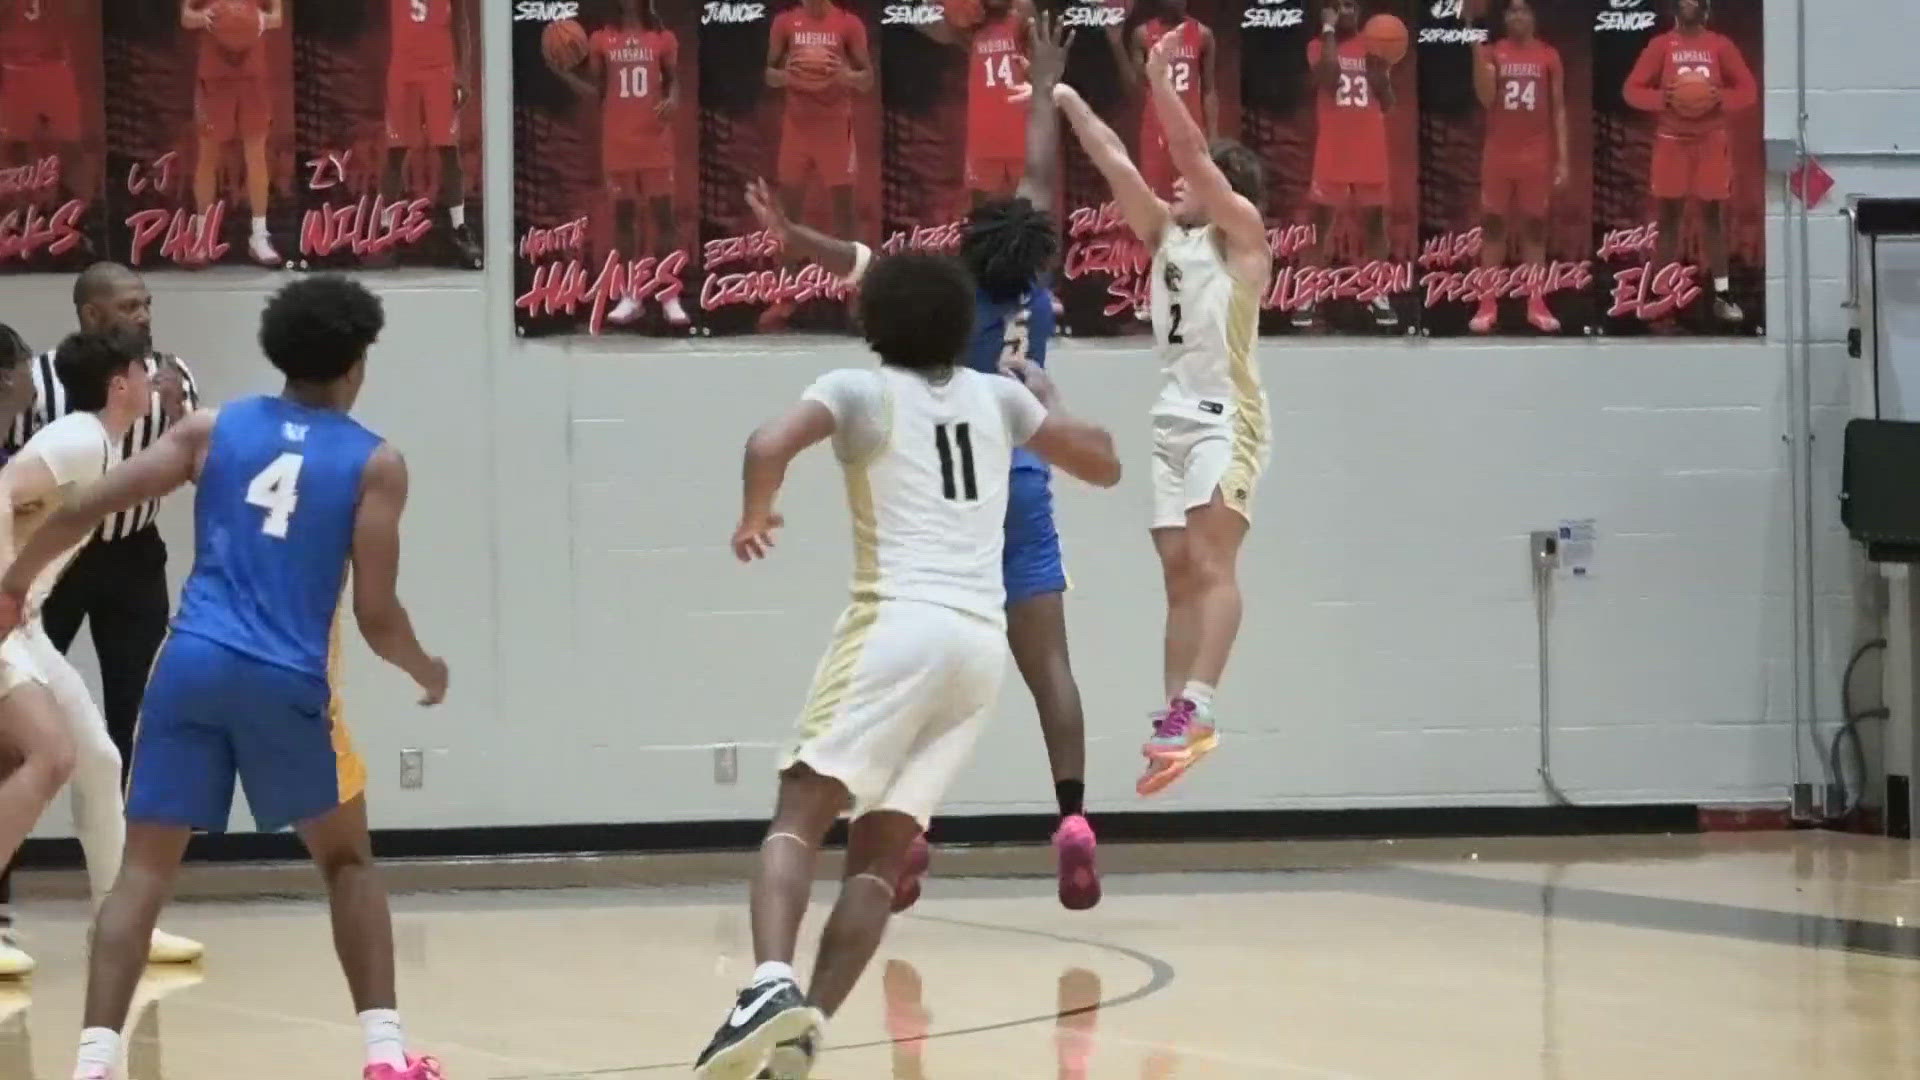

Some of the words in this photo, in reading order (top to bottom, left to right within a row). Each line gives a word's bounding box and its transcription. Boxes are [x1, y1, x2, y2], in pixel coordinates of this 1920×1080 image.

[513, 1, 579, 21] SENIOR
[701, 2, 767, 24] JUNIOR
[881, 5, 945, 25] SENIOR
[1062, 7, 1126, 26] SENIOR
[1240, 8, 1304, 29] SENIOR
[1594, 11, 1657, 32] SENIOR
[795, 31, 838, 46] MARSHALL
[1417, 28, 1489, 45] SOPHOMORE
[609, 48, 654, 63] MARSHALL
[984, 54, 1013, 88] 14
[1672, 50, 1713, 64] MARSHALL
[619, 66, 648, 98] 10
[1336, 73, 1369, 107] 23
[1504, 81, 1536, 111] 24
[305, 149, 352, 190] ZY
[0, 199, 88, 260] CKS
[125, 200, 230, 265] PAUL
[299, 193, 433, 256] WILLIE
[515, 249, 689, 337] HAYNES
[1607, 261, 1702, 319] ELSE
[1167, 303, 1184, 344] 2
[935, 421, 978, 501] 11
[245, 451, 304, 539] 4
